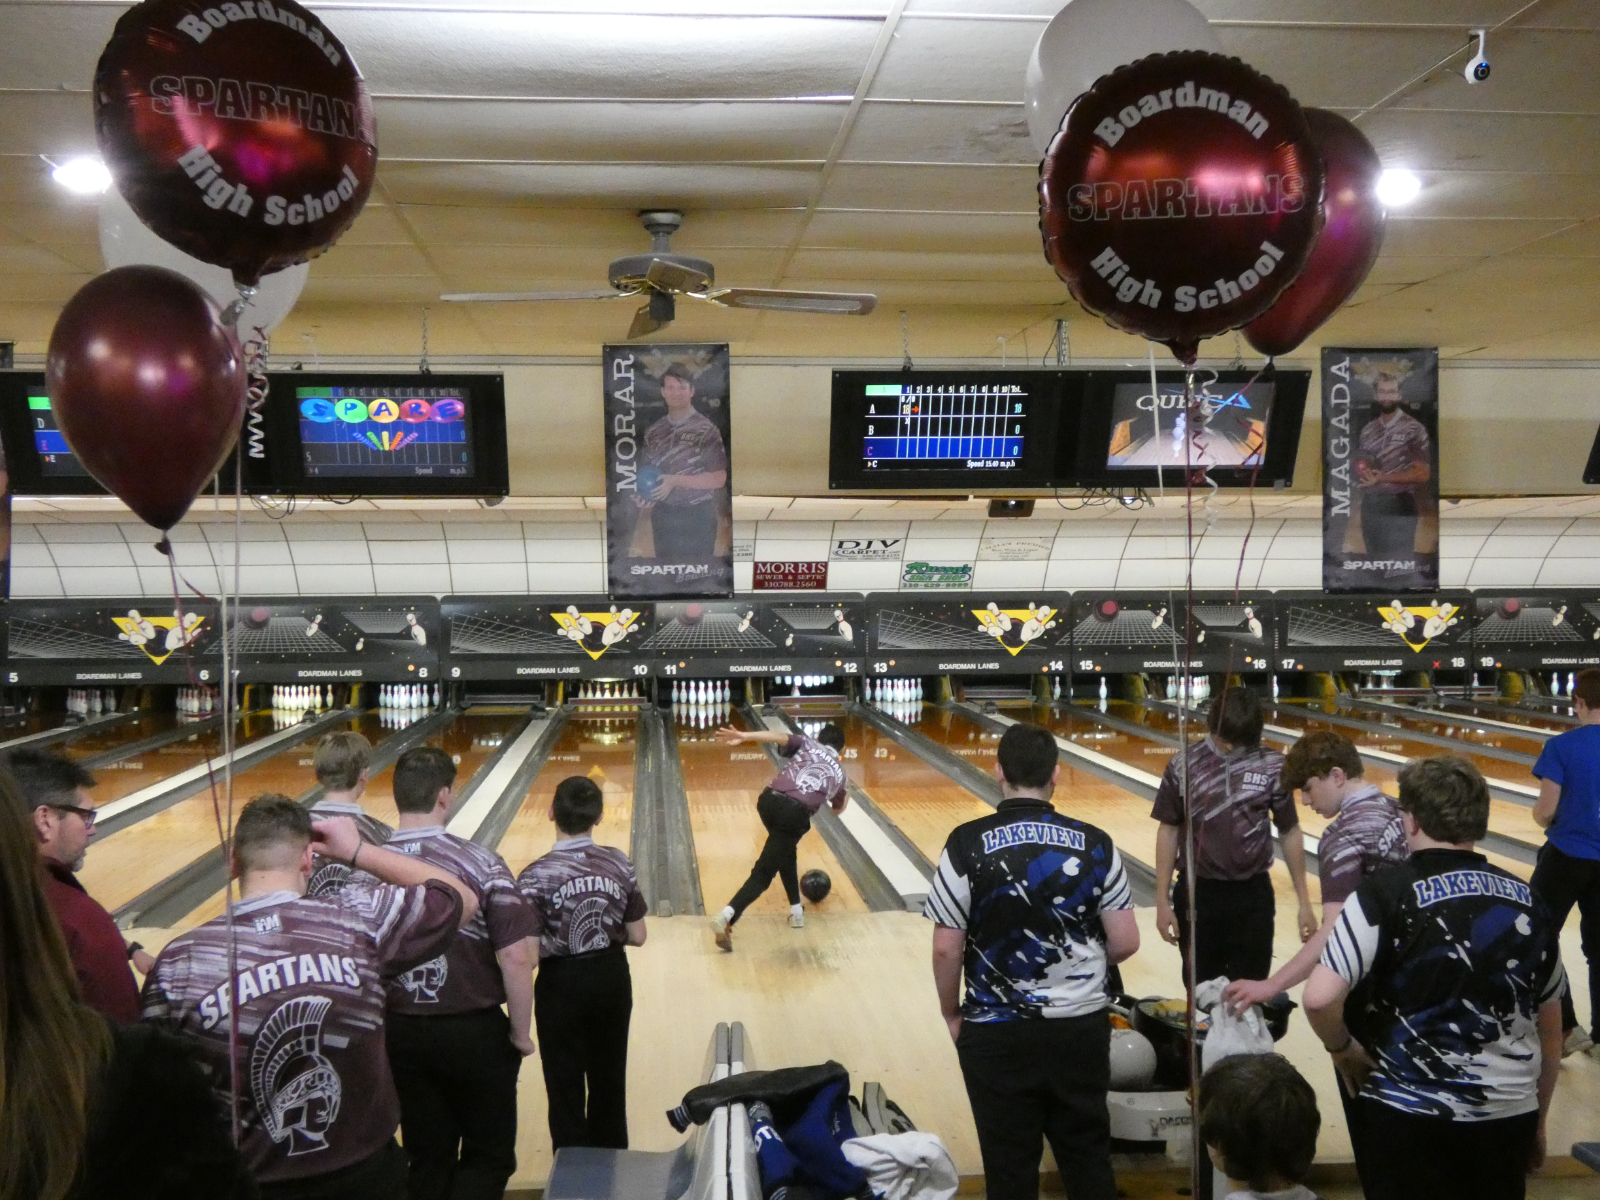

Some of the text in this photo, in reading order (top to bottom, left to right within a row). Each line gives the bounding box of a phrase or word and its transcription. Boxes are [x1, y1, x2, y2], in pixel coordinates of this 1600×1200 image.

[176, 0, 341, 67] Boardman
[1093, 81, 1269, 147] Boardman
[177, 143, 359, 226] High School
[1067, 174, 1305, 222] SPARTANS
[1090, 240, 1285, 313] High School
[308, 401, 461, 419] SPARE
[870, 404, 876, 414] A
[613, 354, 637, 492] MORAR
[868, 425, 874, 435] B
[1331, 357, 1350, 517] MAGADA
[868, 447, 873, 456] C
[872, 460, 878, 468] C
[630, 564, 709, 575] SPARTAN
[757, 563, 826, 574] MORRIS
[1342, 561, 1416, 571] SPARTAN
[1049, 661, 1063, 670] 14
[1080, 660, 1093, 670] 15
[1253, 659, 1266, 669] 16
[1282, 659, 1295, 669] 17
[1451, 658, 1465, 667] 18
[1481, 657, 1494, 666] 19
[419, 667, 428, 677] 8
[452, 667, 460, 677] 9
[633, 665, 648, 675] 10
[664, 665, 676, 674] 11
[843, 663, 857, 673] 12
[874, 663, 887, 672] 13
[9, 673, 18, 682] 5
[200, 670, 209, 680] 6
[1243, 772, 1268, 785] BHS
[982, 822, 1085, 854] LAKEVIEW
[552, 876, 621, 909] SPARTANS
[1413, 870, 1532, 908] LAKEVIEW
